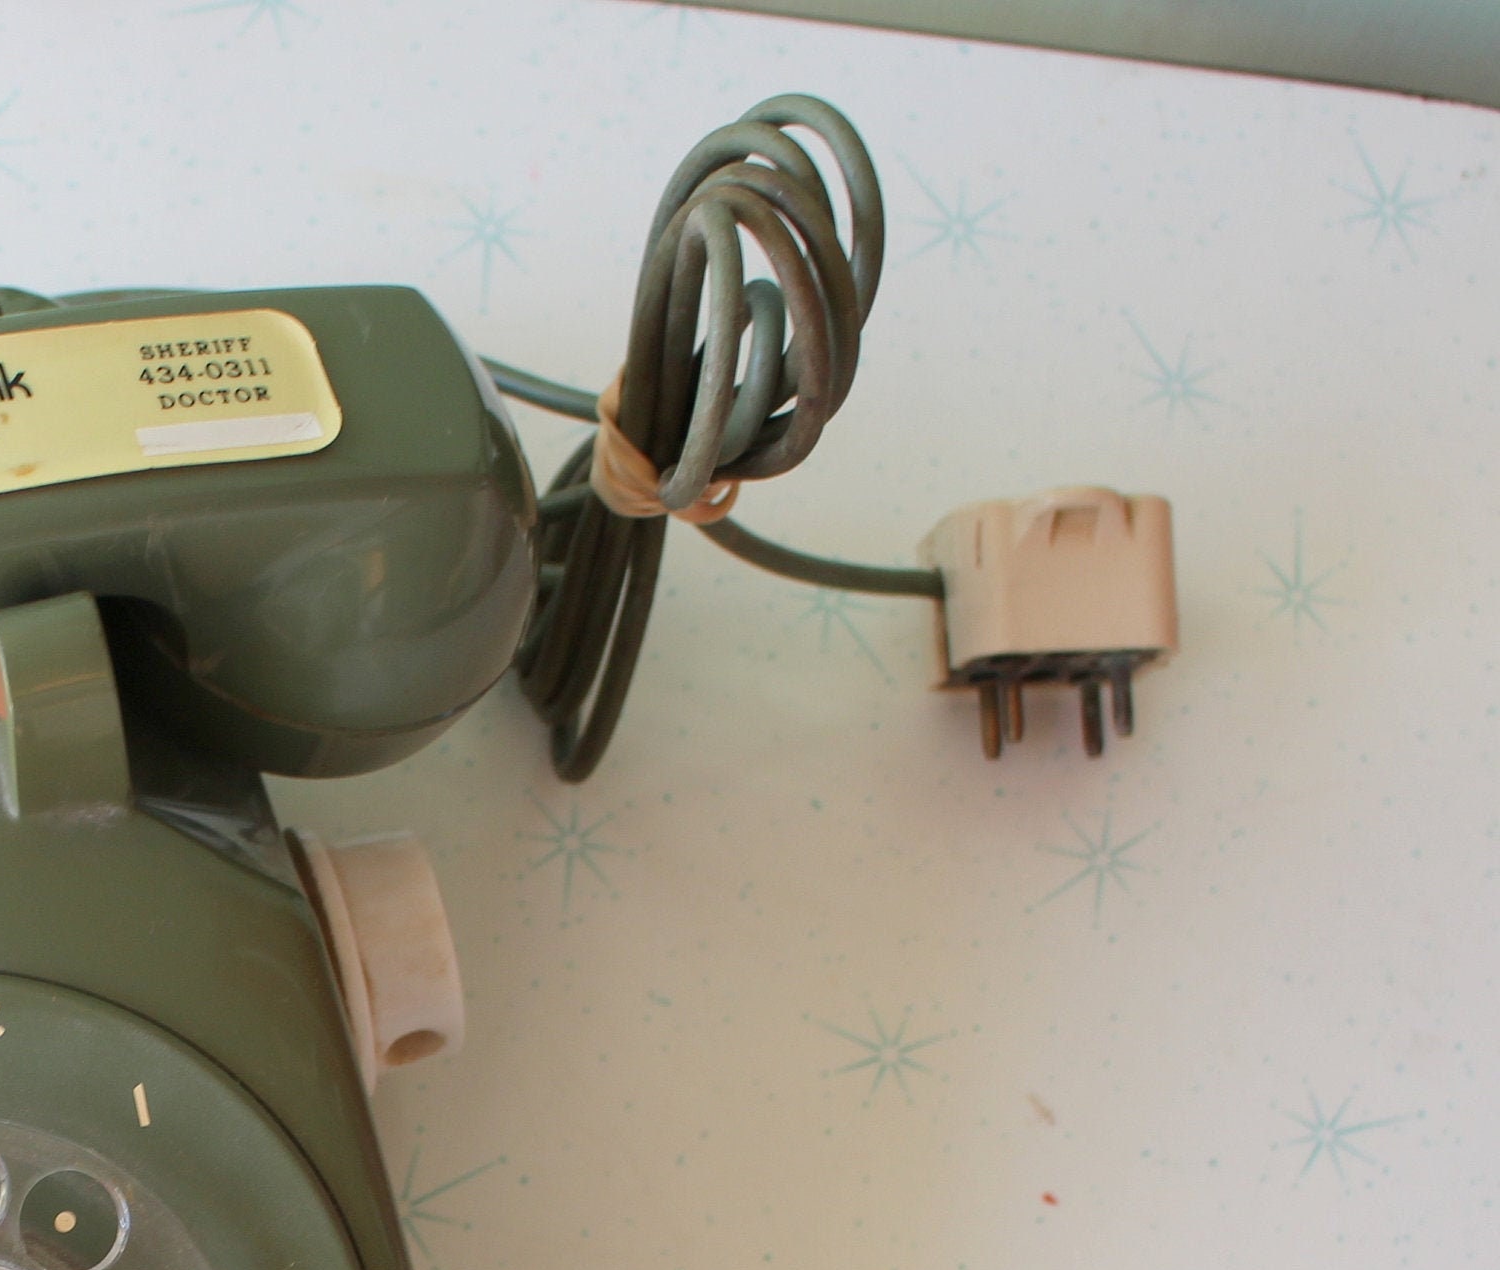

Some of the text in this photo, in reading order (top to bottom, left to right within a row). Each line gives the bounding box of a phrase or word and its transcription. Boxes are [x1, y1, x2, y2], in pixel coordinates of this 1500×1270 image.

[139, 336, 252, 360] SHERIFF
[139, 358, 273, 385] 434-0311
[158, 386, 271, 410] DOCTOR
